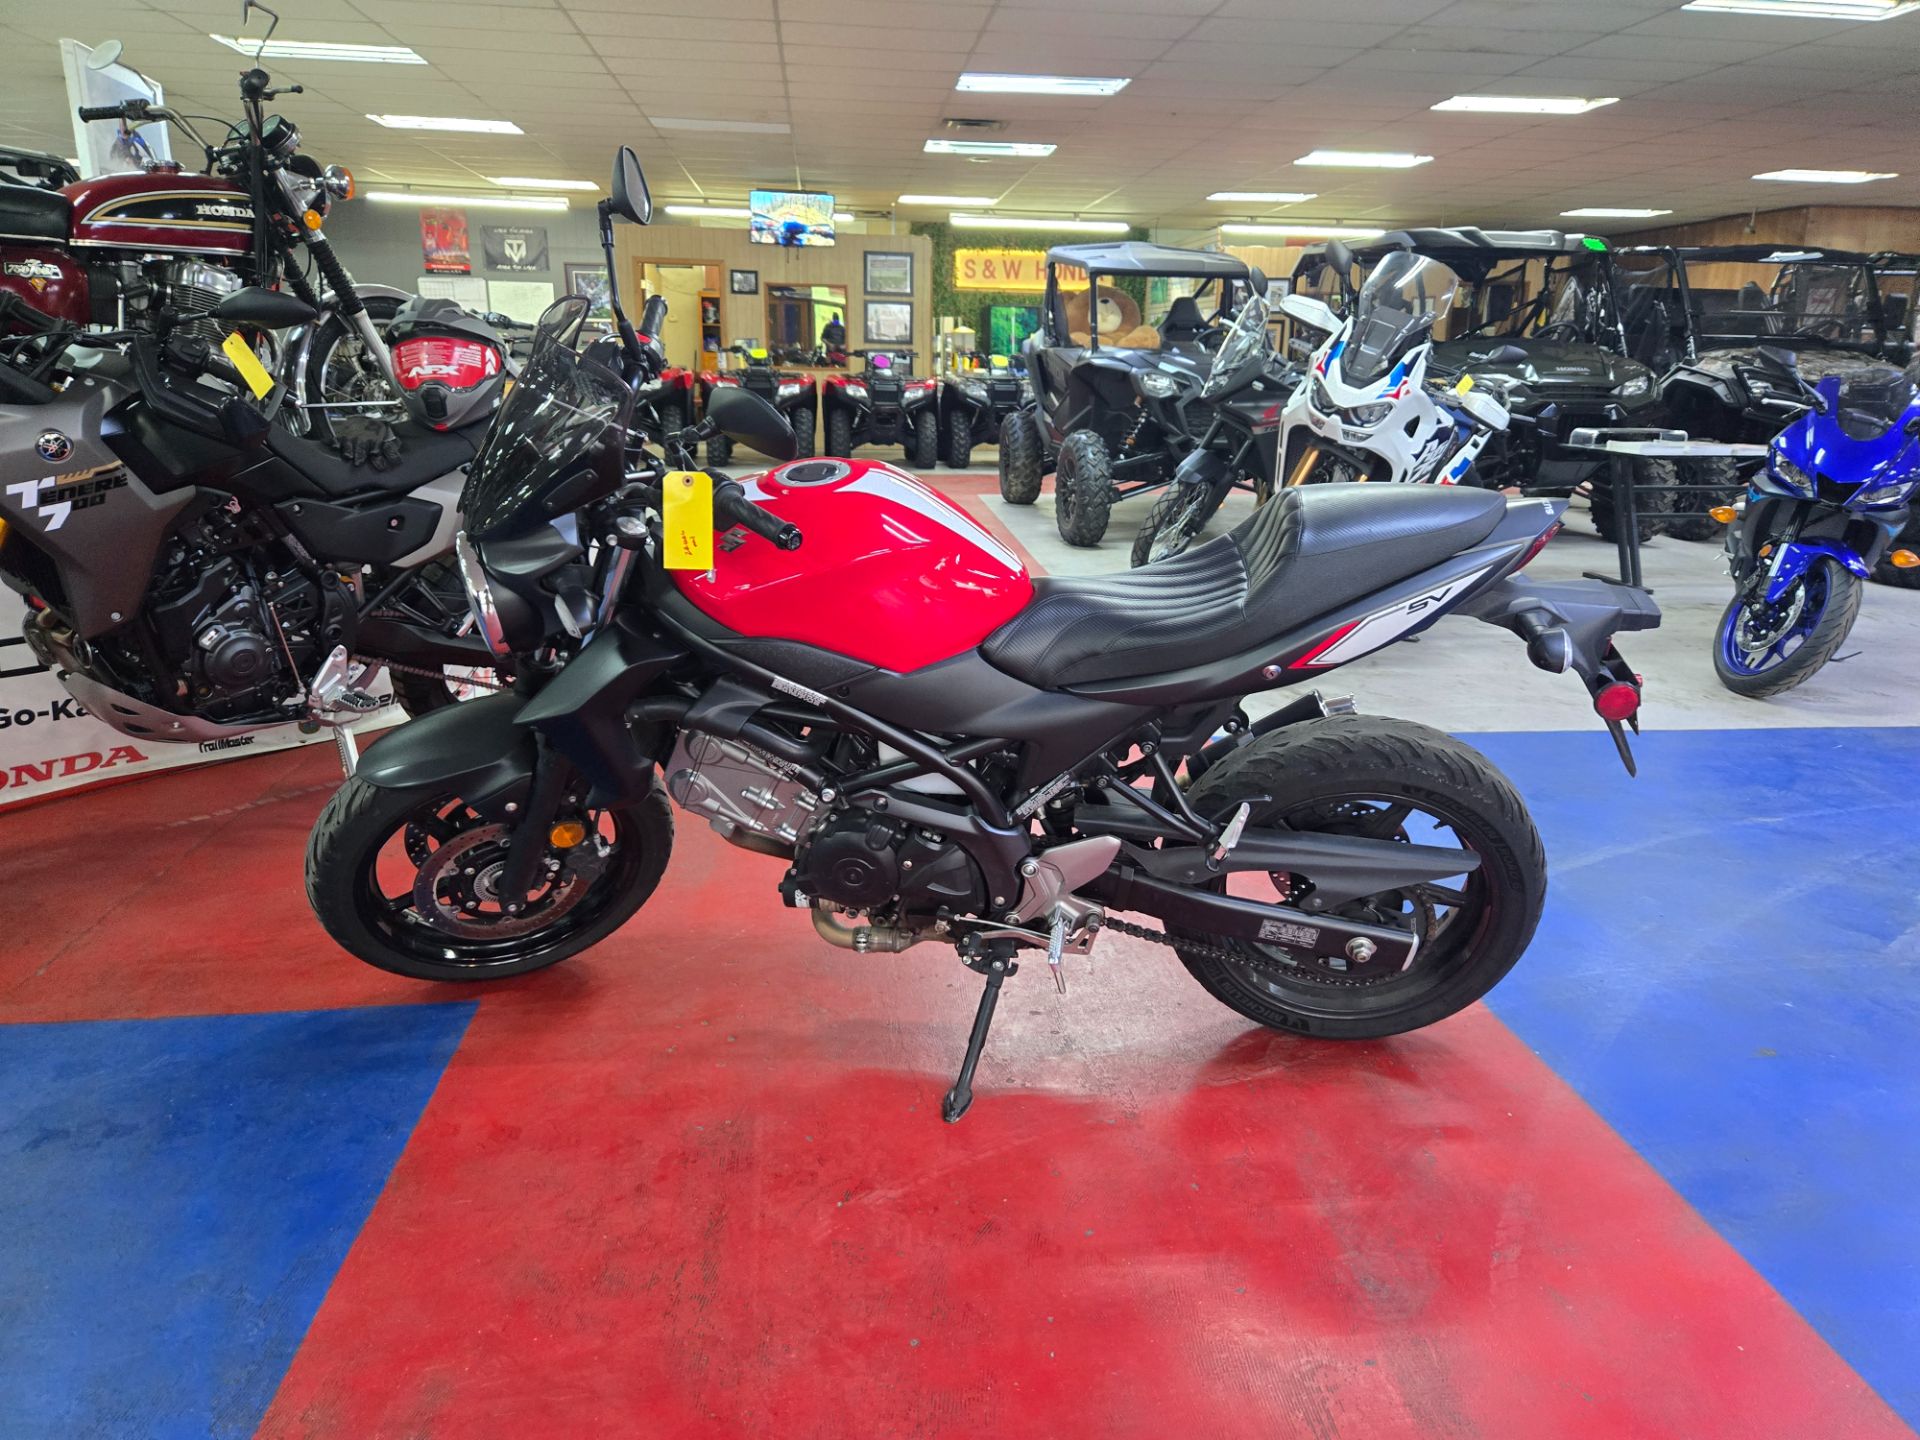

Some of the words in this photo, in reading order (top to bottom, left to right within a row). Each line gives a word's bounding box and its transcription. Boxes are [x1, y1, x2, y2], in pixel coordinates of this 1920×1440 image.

[196, 204, 256, 219] HONDA
[964, 259, 976, 279] S
[982, 259, 996, 280] &
[1003, 260, 1022, 280] W
[1406, 586, 1454, 616] SV
[199, 735, 255, 753] TrailMaster
[0, 745, 149, 790] NDA
[1220, 978, 1285, 1025] MICHELIN
